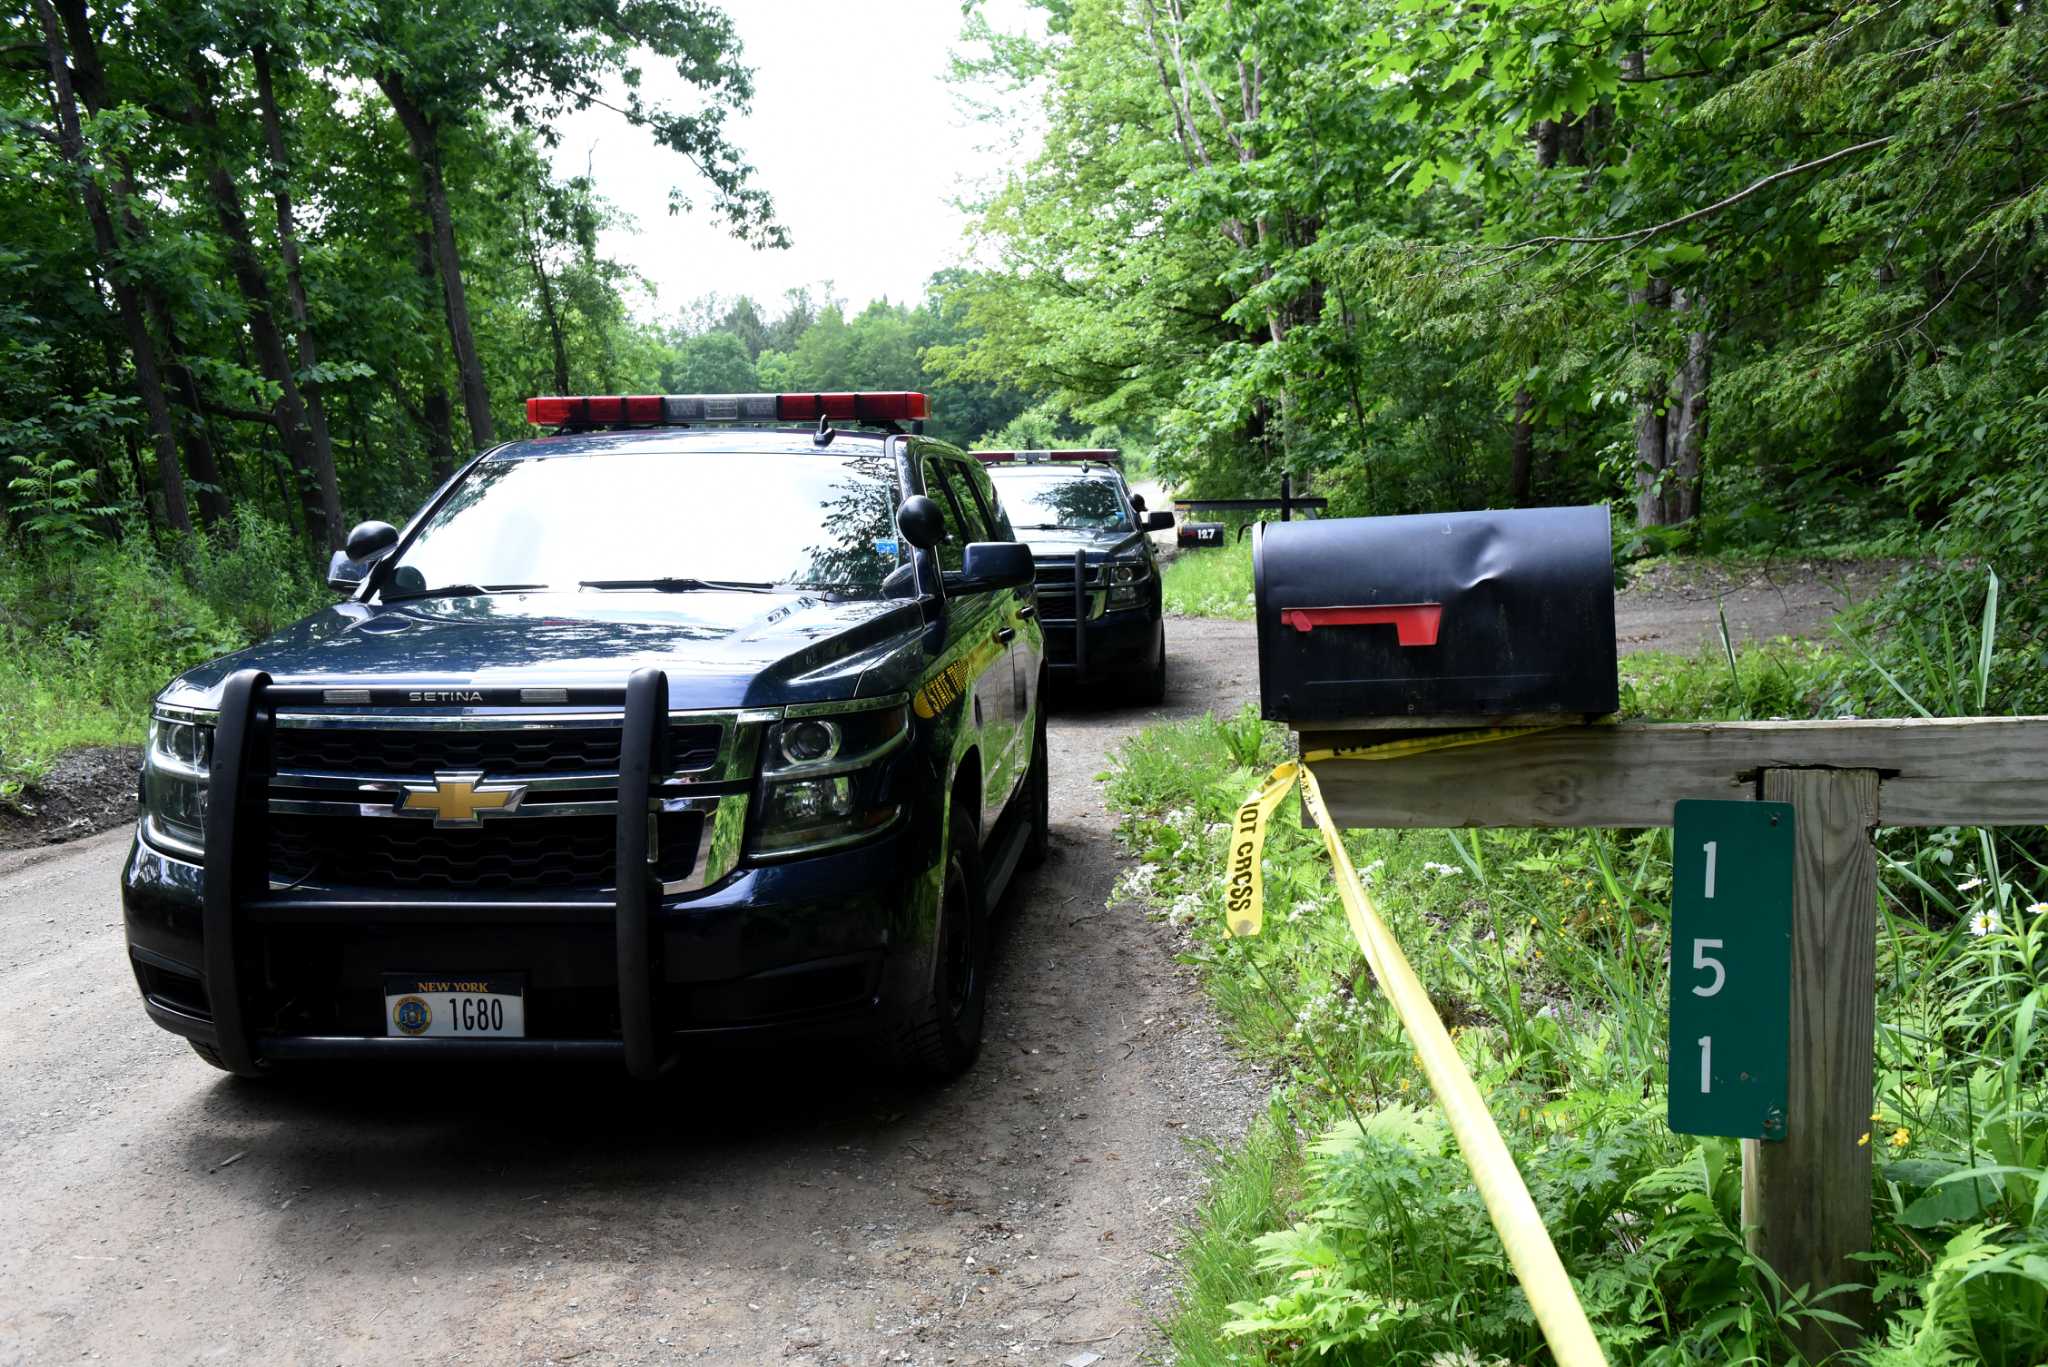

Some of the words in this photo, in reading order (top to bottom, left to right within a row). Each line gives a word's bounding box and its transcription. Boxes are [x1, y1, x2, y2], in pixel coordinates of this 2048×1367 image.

[1197, 528, 1215, 539] 127
[409, 691, 483, 702] SETINA
[417, 982, 450, 993] NEW
[454, 982, 488, 993] YORK
[449, 998, 503, 1031] 1G80
